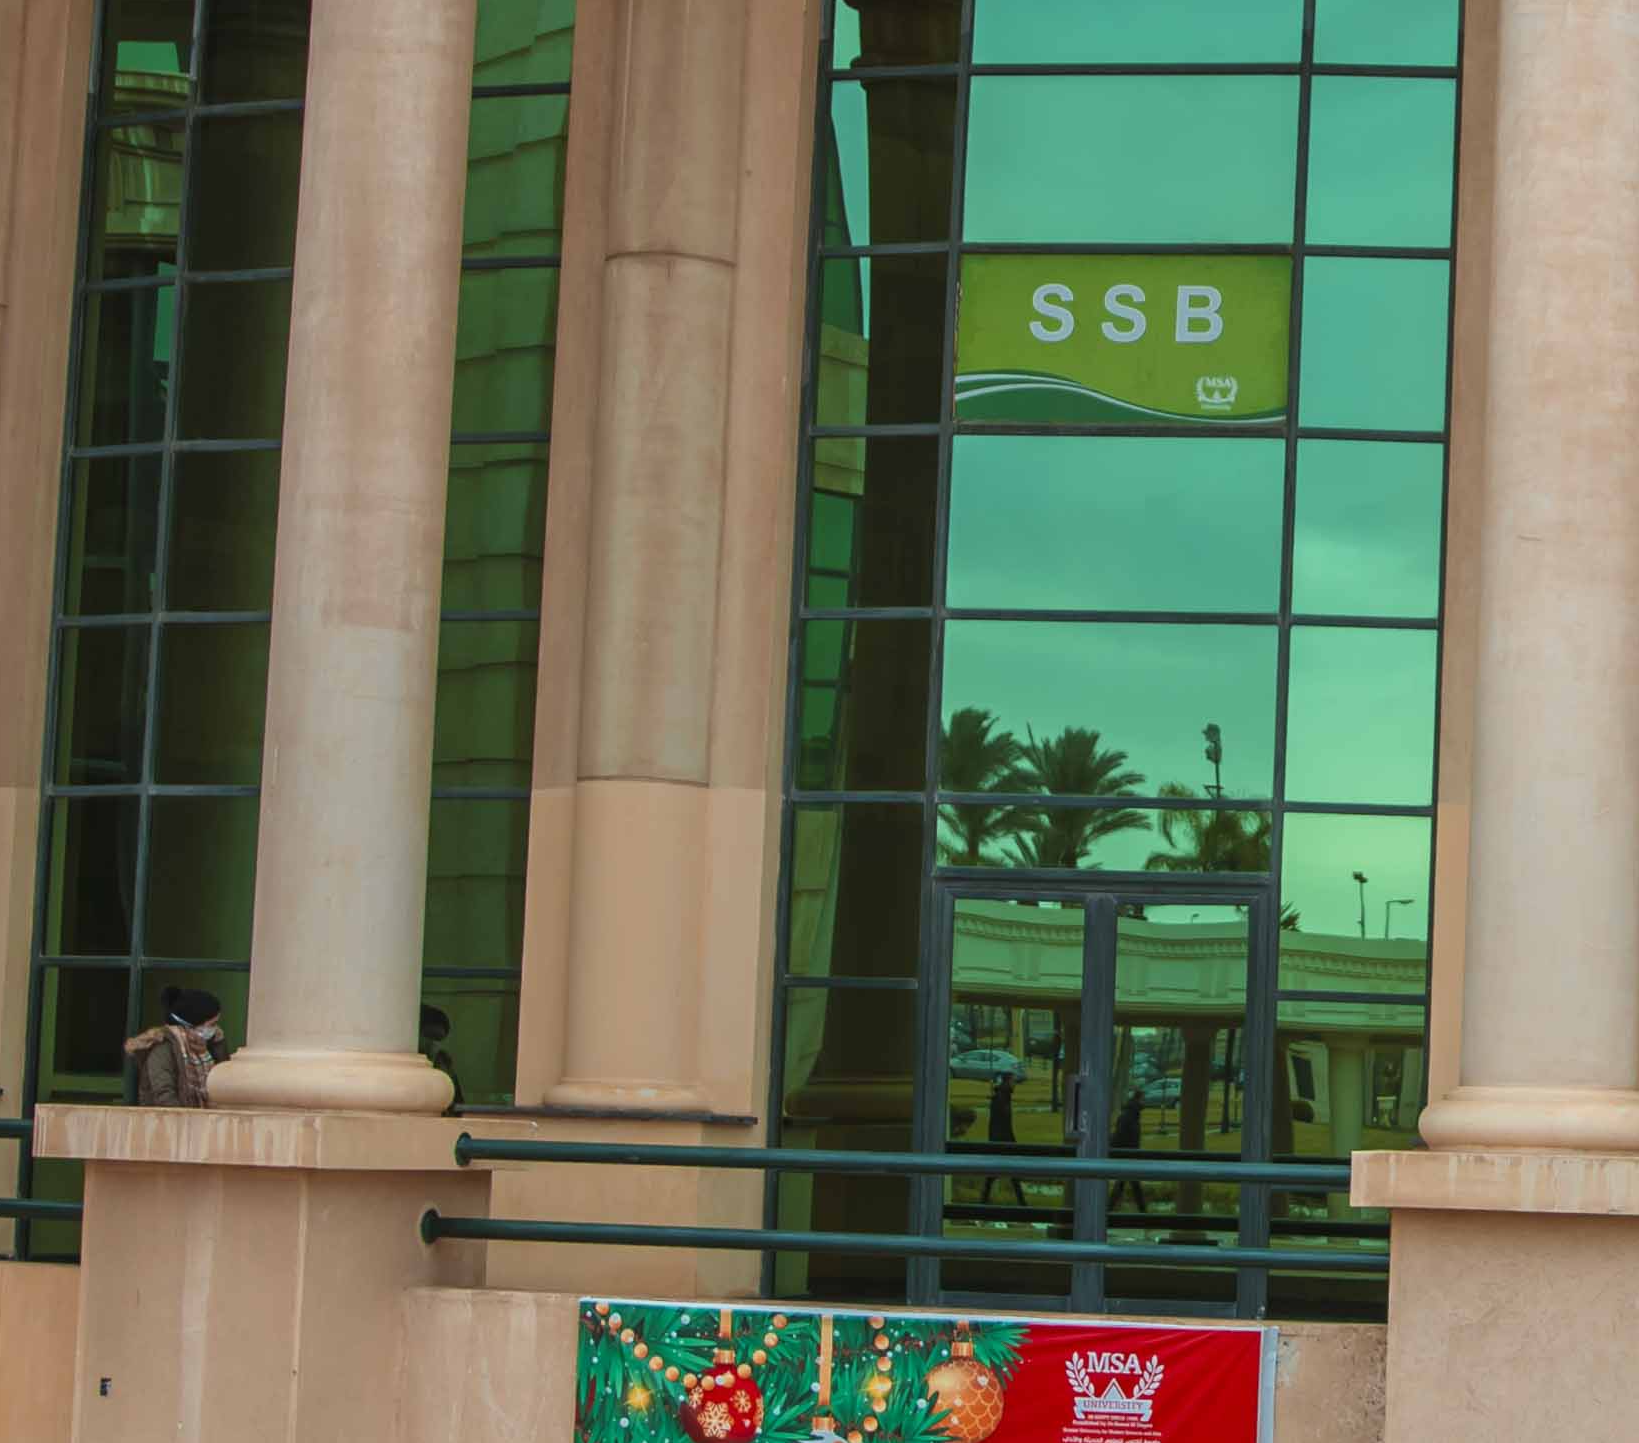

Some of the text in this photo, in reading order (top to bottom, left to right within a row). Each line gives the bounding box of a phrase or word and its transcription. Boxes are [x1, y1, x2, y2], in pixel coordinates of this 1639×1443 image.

[1028, 283, 1225, 344] SSB
[1087, 1351, 1142, 1375] MSA
[1083, 1400, 1144, 1411] UNIVERSITY
